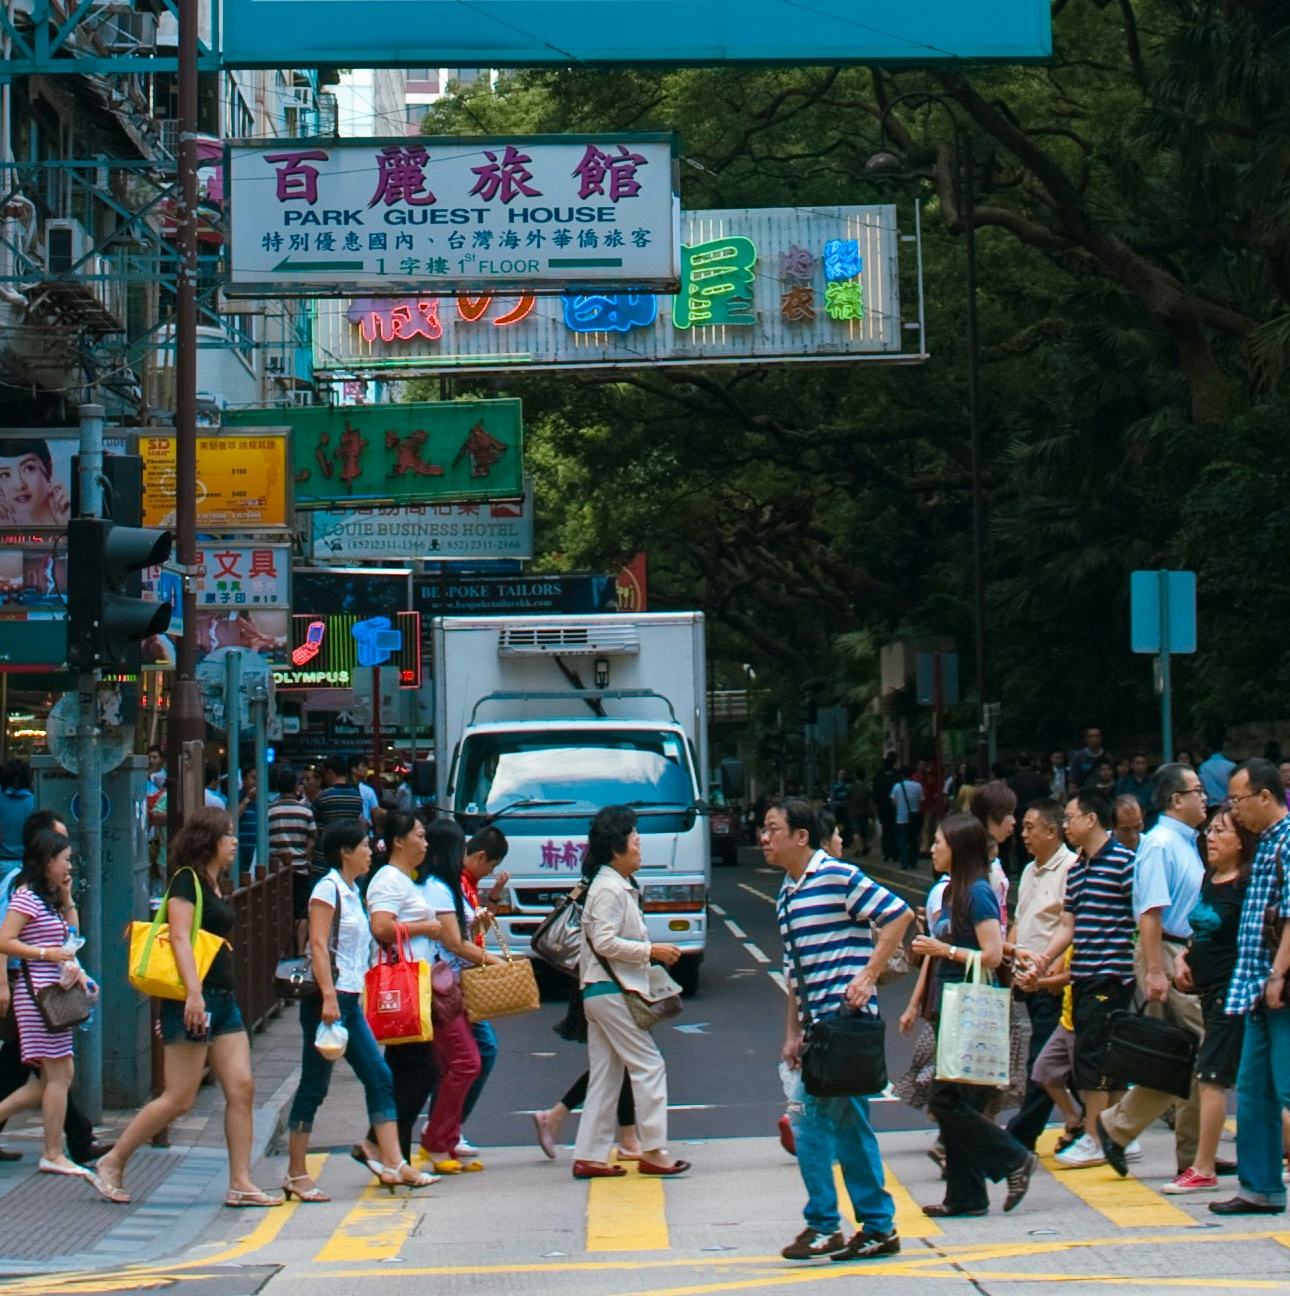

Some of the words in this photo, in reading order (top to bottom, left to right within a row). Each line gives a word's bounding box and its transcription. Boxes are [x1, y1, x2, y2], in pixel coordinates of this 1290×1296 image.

[263, 144, 650, 208] 百麗旅館
[283, 208, 363, 226] PARK
[383, 207, 491, 225] GUEST
[508, 206, 617, 224] HOUSE
[479, 259, 540, 274] FLOOR
[323, 523, 374, 537] LOUIE
[376, 523, 458, 537] BUSINESS
[462, 522, 518, 537] HOTEL
[422, 585, 489, 599] BEPOKE
[497, 583, 562, 598] TAILORS
[274, 670, 349, 684] OLYMPUS
[363, 724, 397, 735] Sttion
